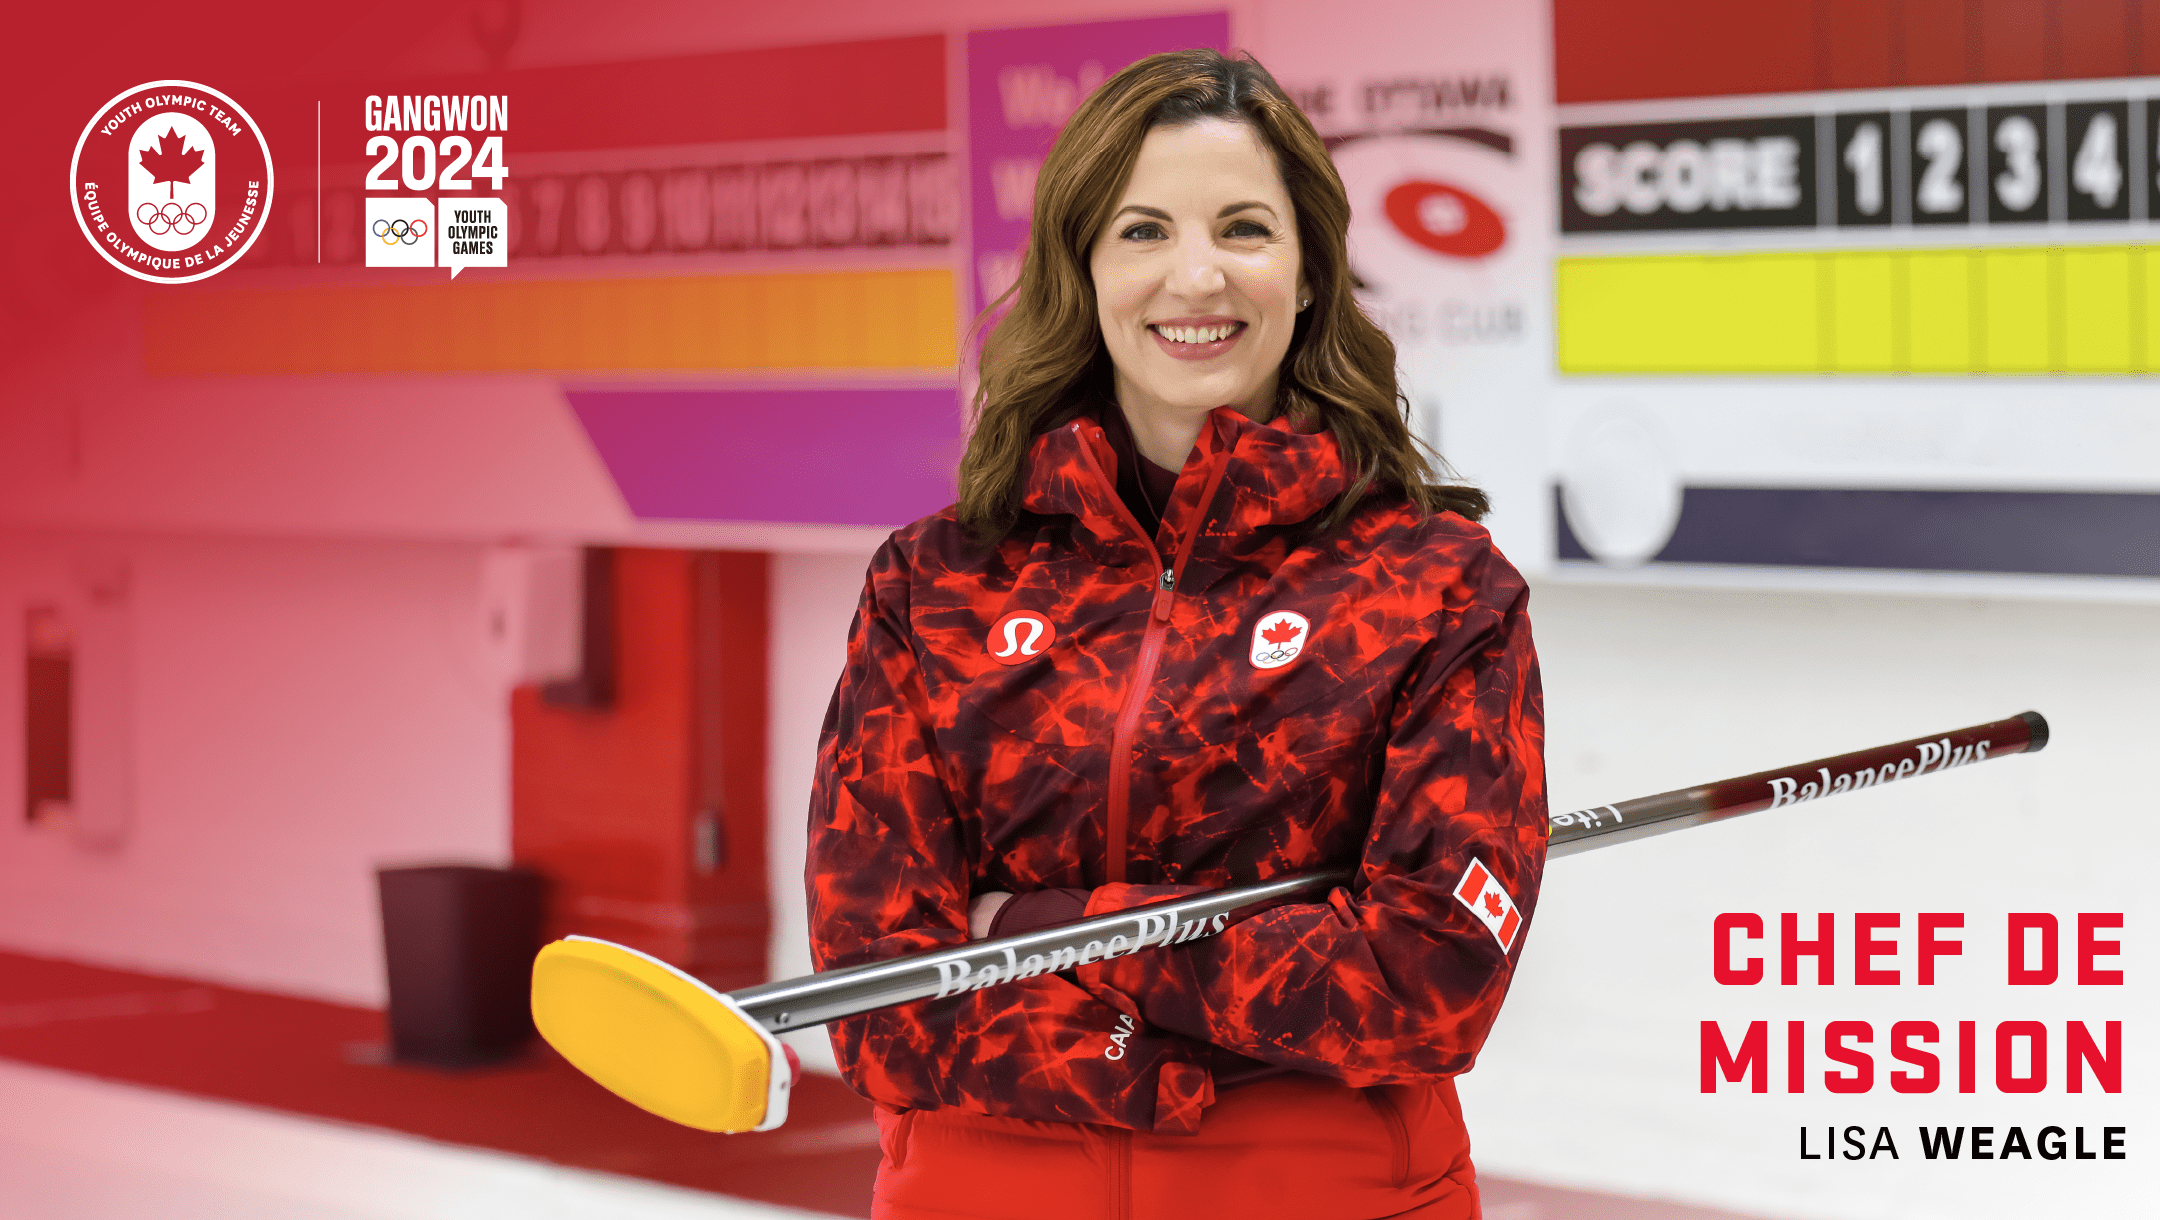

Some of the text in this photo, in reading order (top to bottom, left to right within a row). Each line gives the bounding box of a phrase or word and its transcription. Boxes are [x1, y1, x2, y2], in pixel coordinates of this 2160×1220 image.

[1574, 110, 2122, 216] SCORE 1 2 3 4
[1767, 738, 1991, 810] BalancePlus
[1552, 804, 1623, 829] Lite
[933, 910, 1229, 1000] BalancePlus
